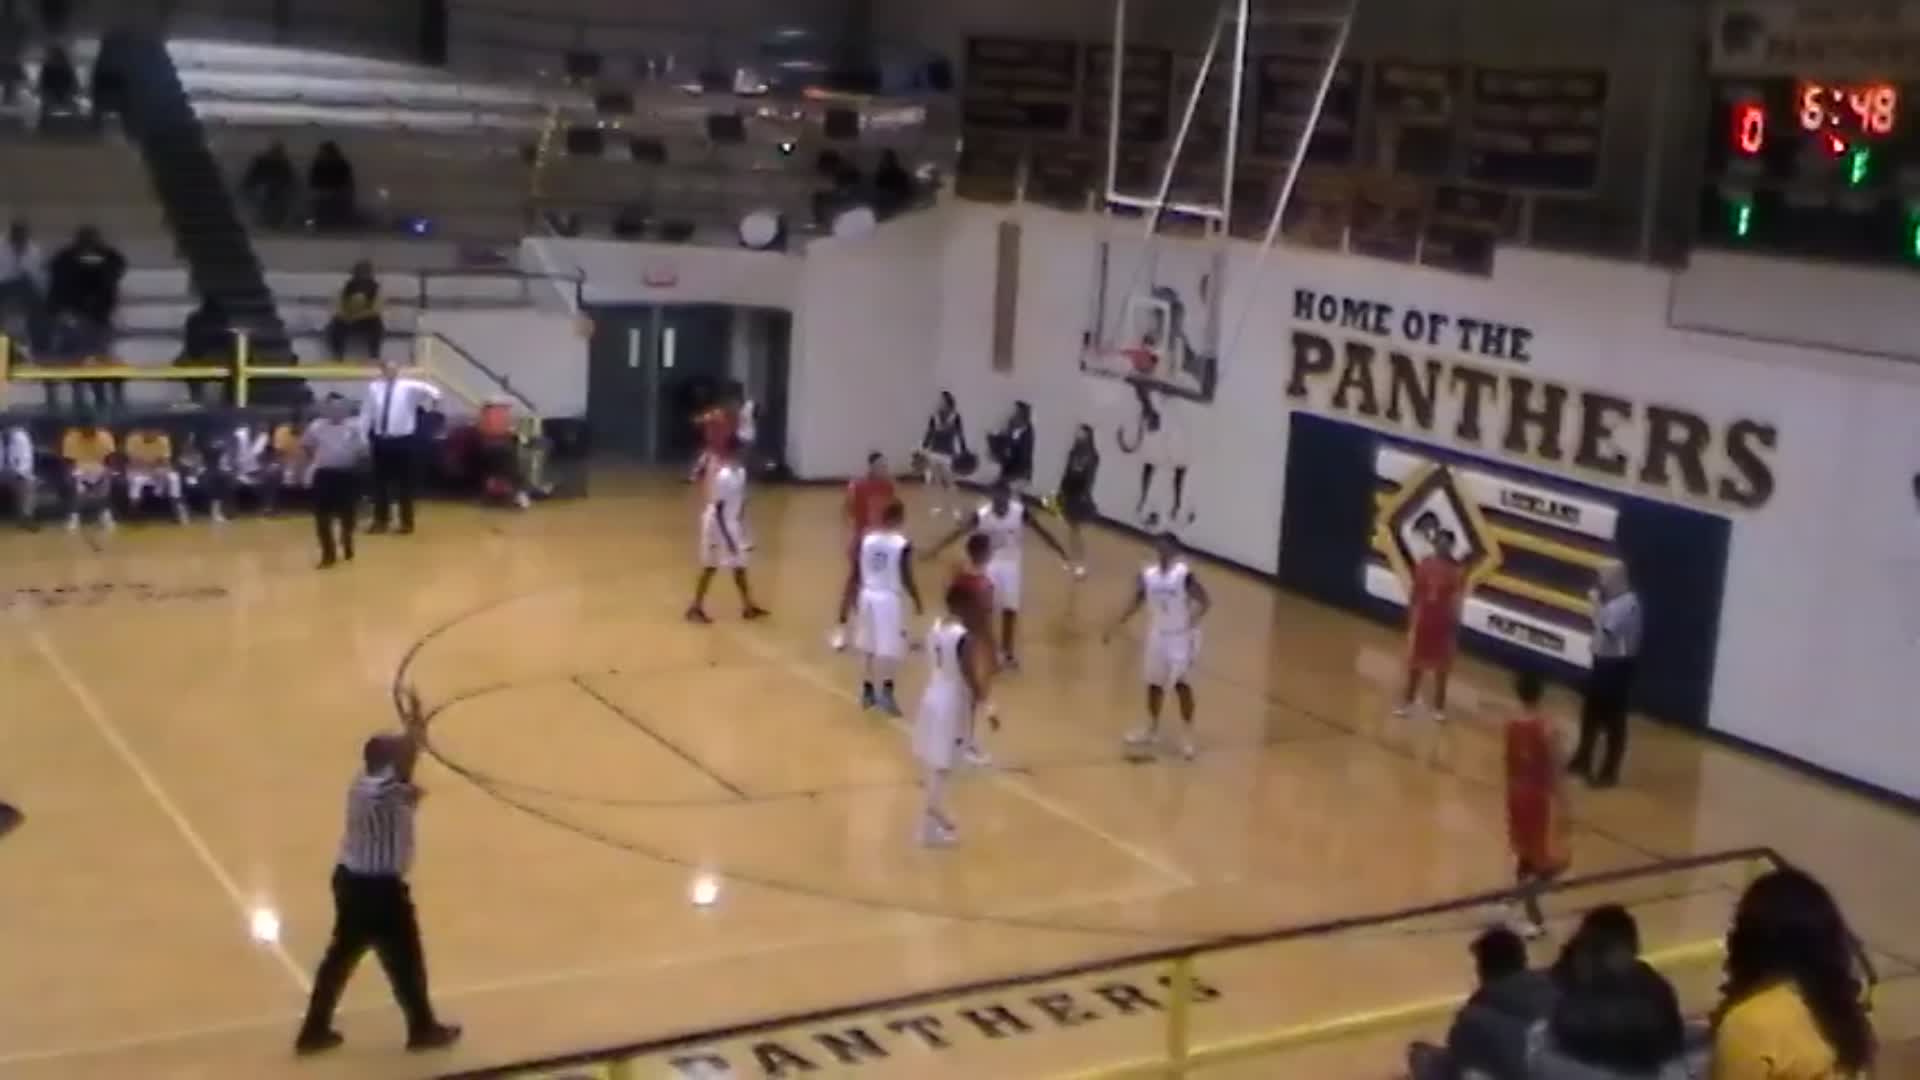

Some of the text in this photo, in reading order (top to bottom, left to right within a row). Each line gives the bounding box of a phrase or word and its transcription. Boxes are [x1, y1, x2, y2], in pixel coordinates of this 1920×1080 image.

[1741, 85, 1897, 153] 0 6:48
[1293, 288, 1534, 361] HOME OF THE
[1286, 331, 1778, 508] PANTHERS
